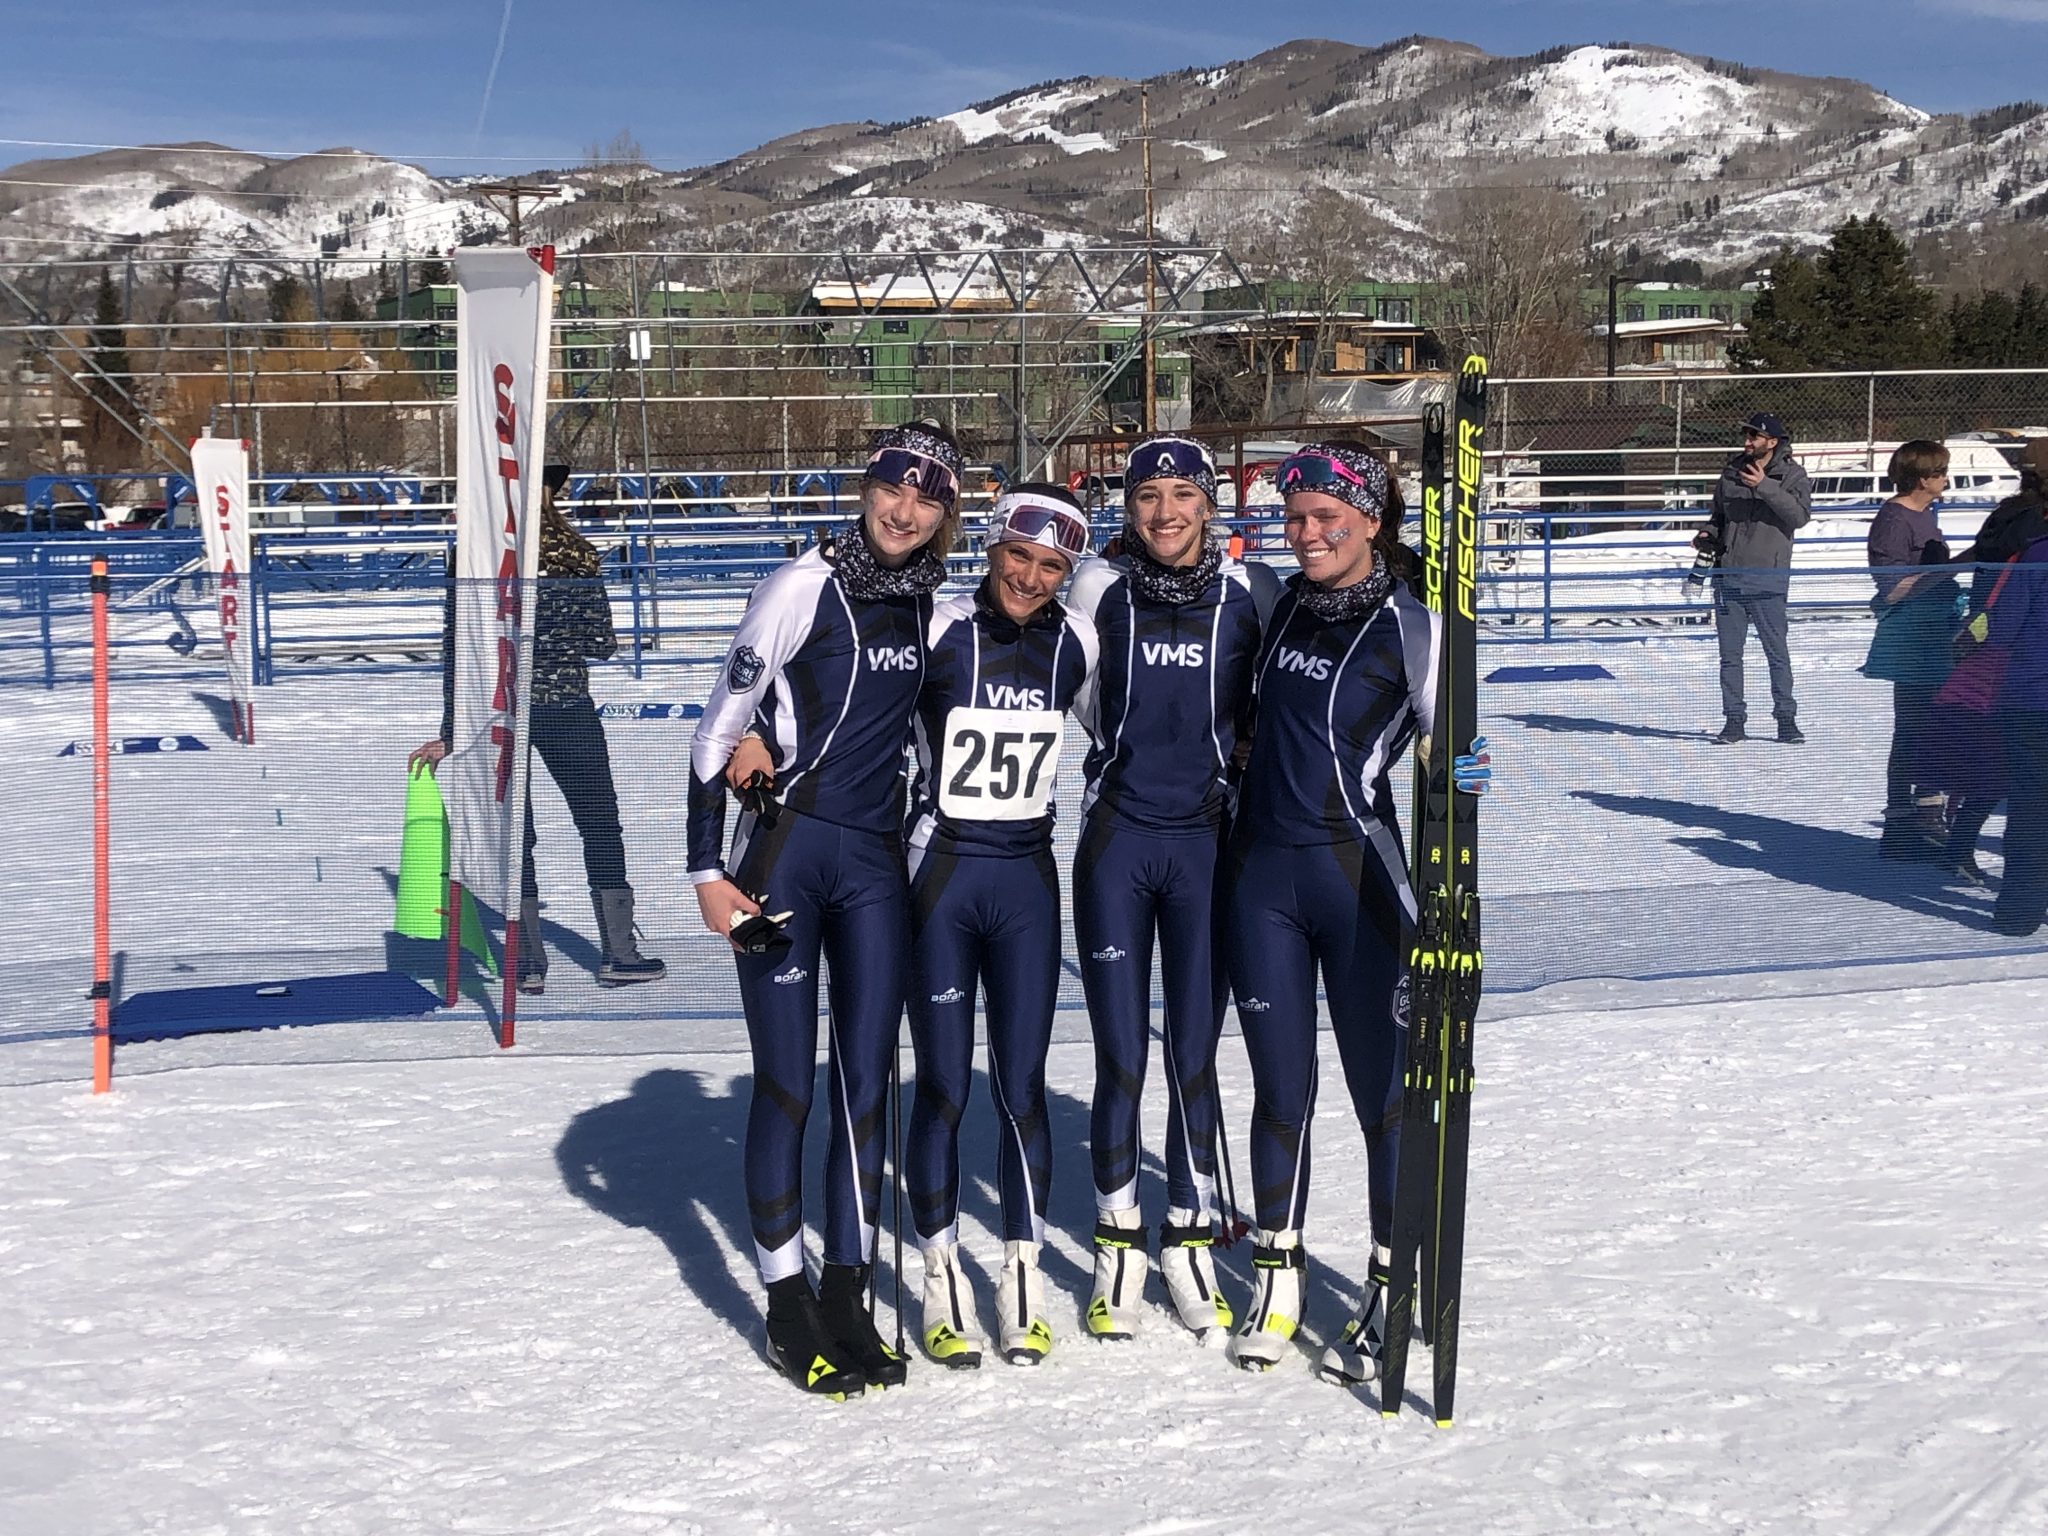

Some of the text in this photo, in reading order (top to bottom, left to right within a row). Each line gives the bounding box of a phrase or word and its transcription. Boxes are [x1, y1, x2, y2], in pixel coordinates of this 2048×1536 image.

[1458, 419, 1478, 620] FISCHER
[1425, 486, 1441, 614] SCHER
[215, 485, 238, 660] START
[867, 646, 918, 671] VMS
[1142, 642, 1204, 667] VMS
[1277, 646, 1333, 681] VMS
[734, 661, 756, 680] GORE
[985, 683, 1045, 711] VMS
[948, 729, 1057, 800] 257
[1430, 848, 1441, 864] 3D
[1461, 849, 1470, 865] 3D
